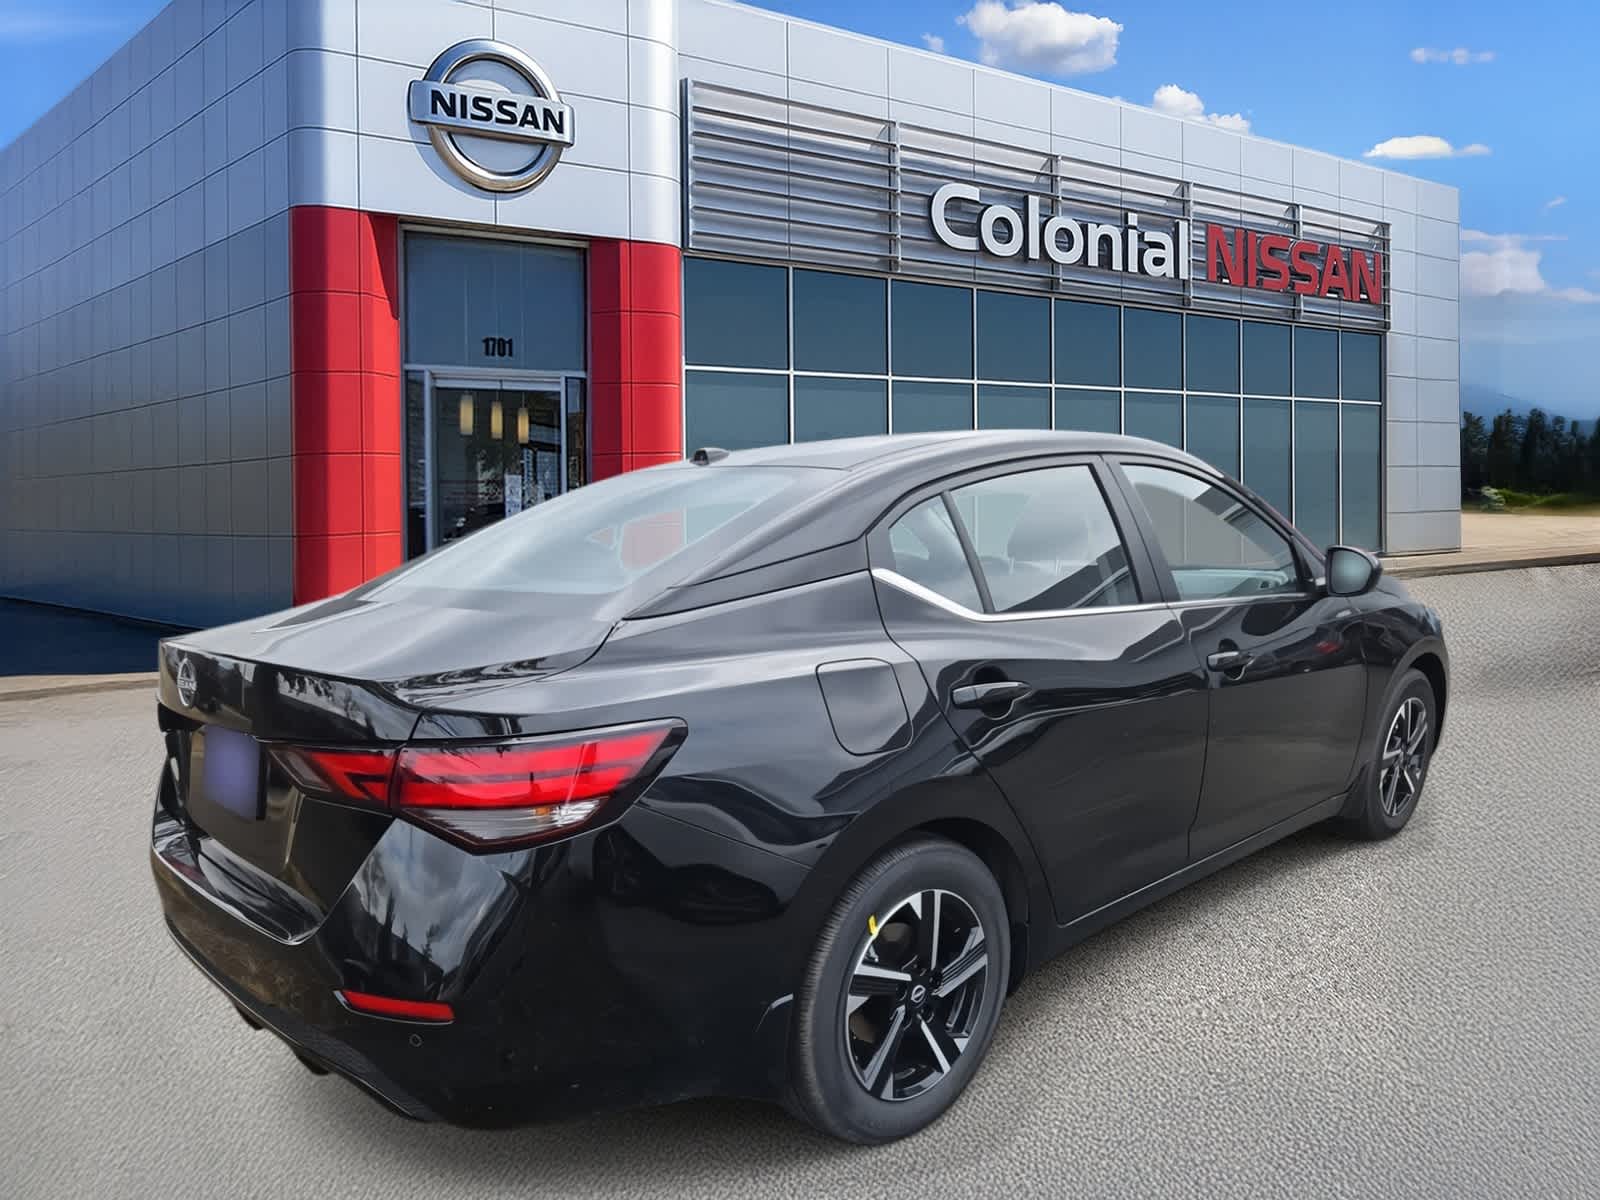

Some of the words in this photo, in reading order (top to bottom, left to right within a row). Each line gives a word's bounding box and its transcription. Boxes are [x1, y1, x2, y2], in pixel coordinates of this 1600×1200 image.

[430, 89, 564, 134] NISSAN
[930, 182, 1189, 280] Colonial
[1206, 223, 1382, 305] NISSAN
[482, 337, 513, 357] 1701
